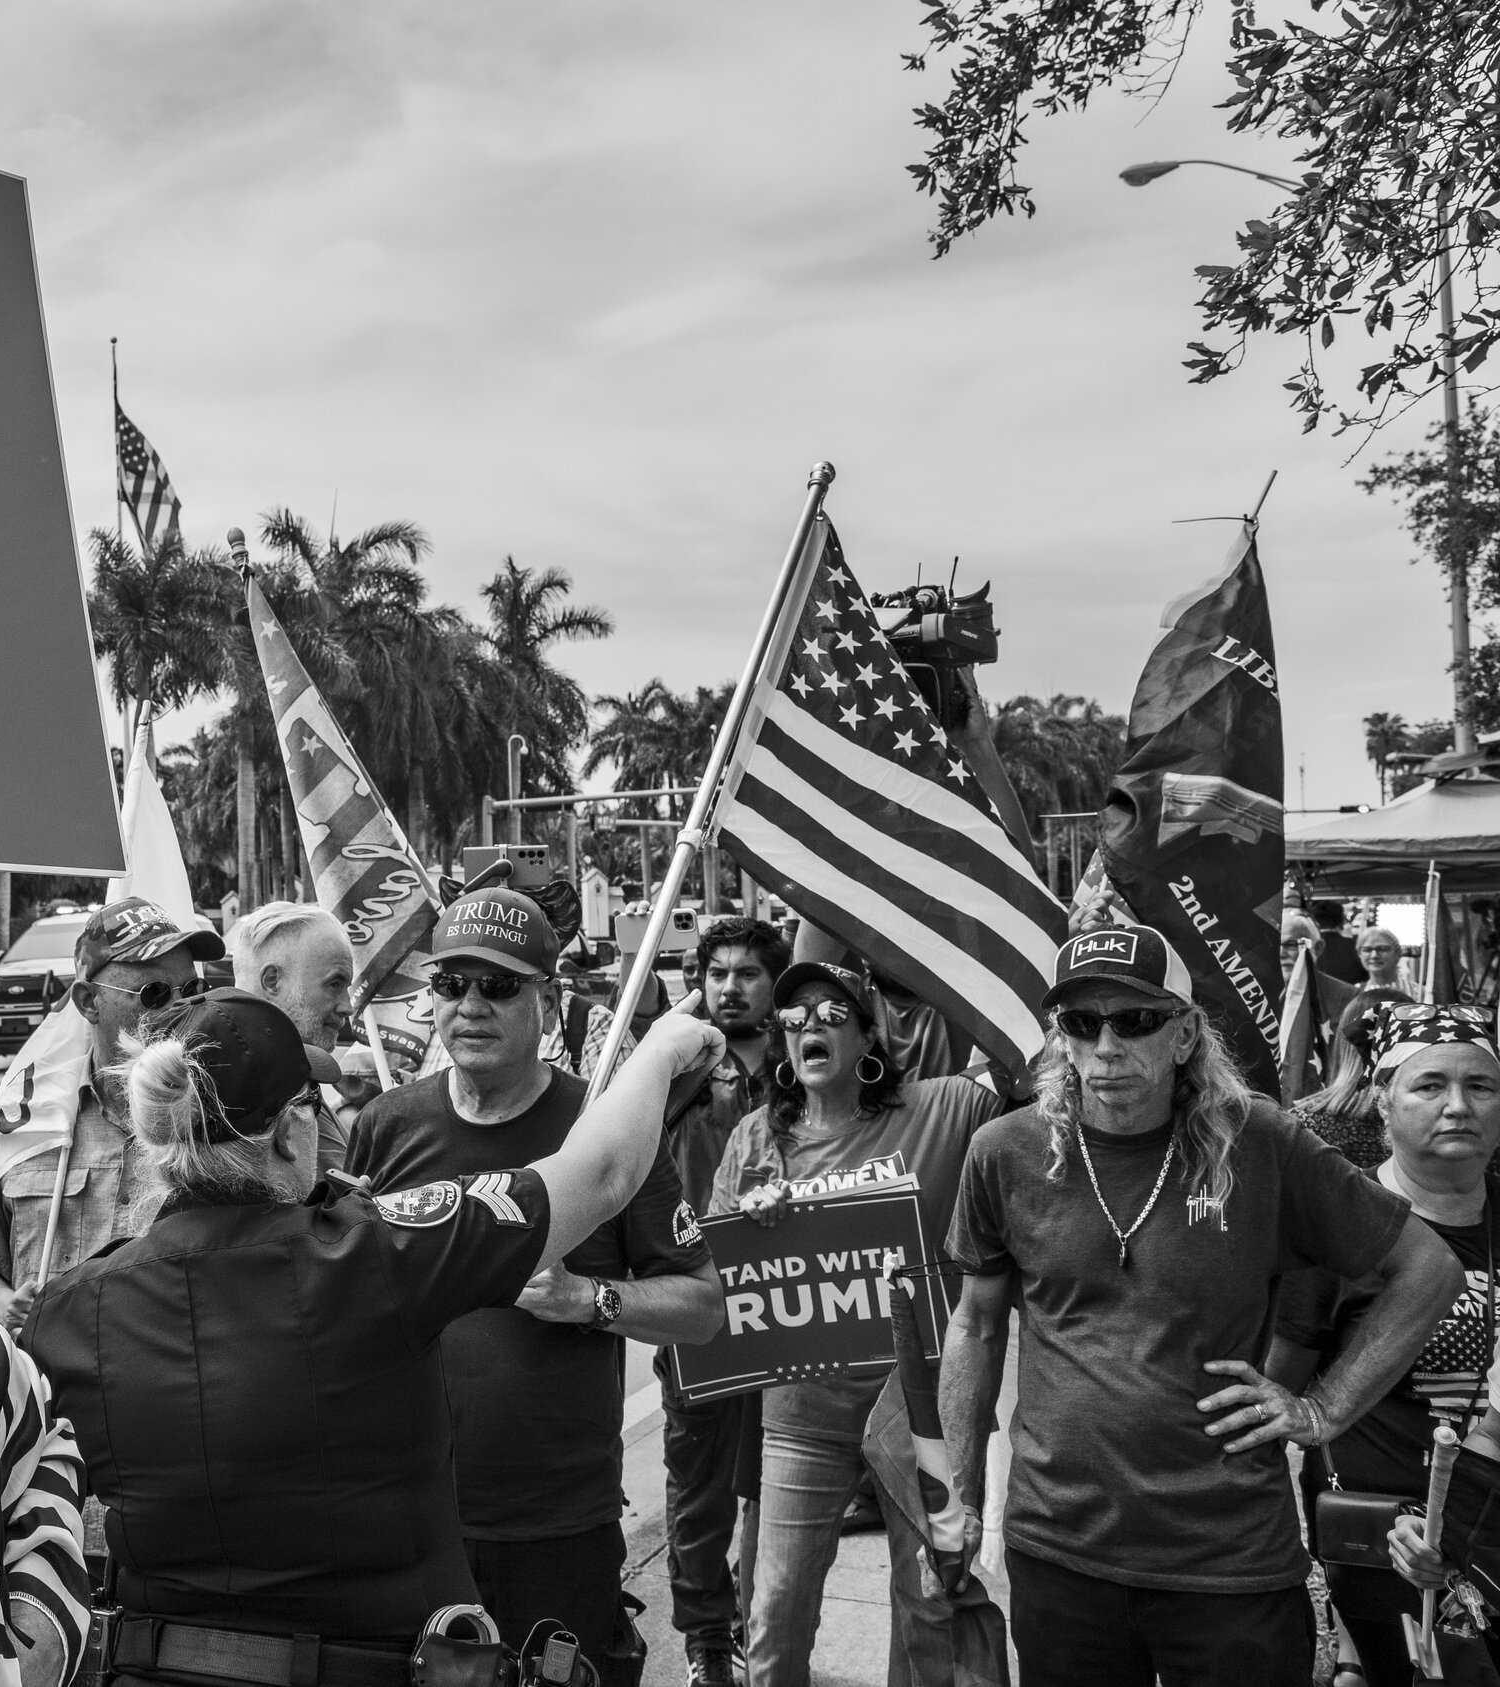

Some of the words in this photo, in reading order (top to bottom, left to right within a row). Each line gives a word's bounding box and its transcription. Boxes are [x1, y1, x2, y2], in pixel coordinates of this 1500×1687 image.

[453, 901, 529, 929] TRUMP
[446, 925, 460, 937] ES
[462, 923, 483, 935] UN
[484, 924, 528, 946] PINGU
[1077, 938, 1127, 957] HUK
[1168, 875, 1219, 935] 2nd
[1205, 938, 1283, 1078] AMEND
[720, 1256, 807, 1287] TAND
[725, 1277, 916, 1336] RUMP
